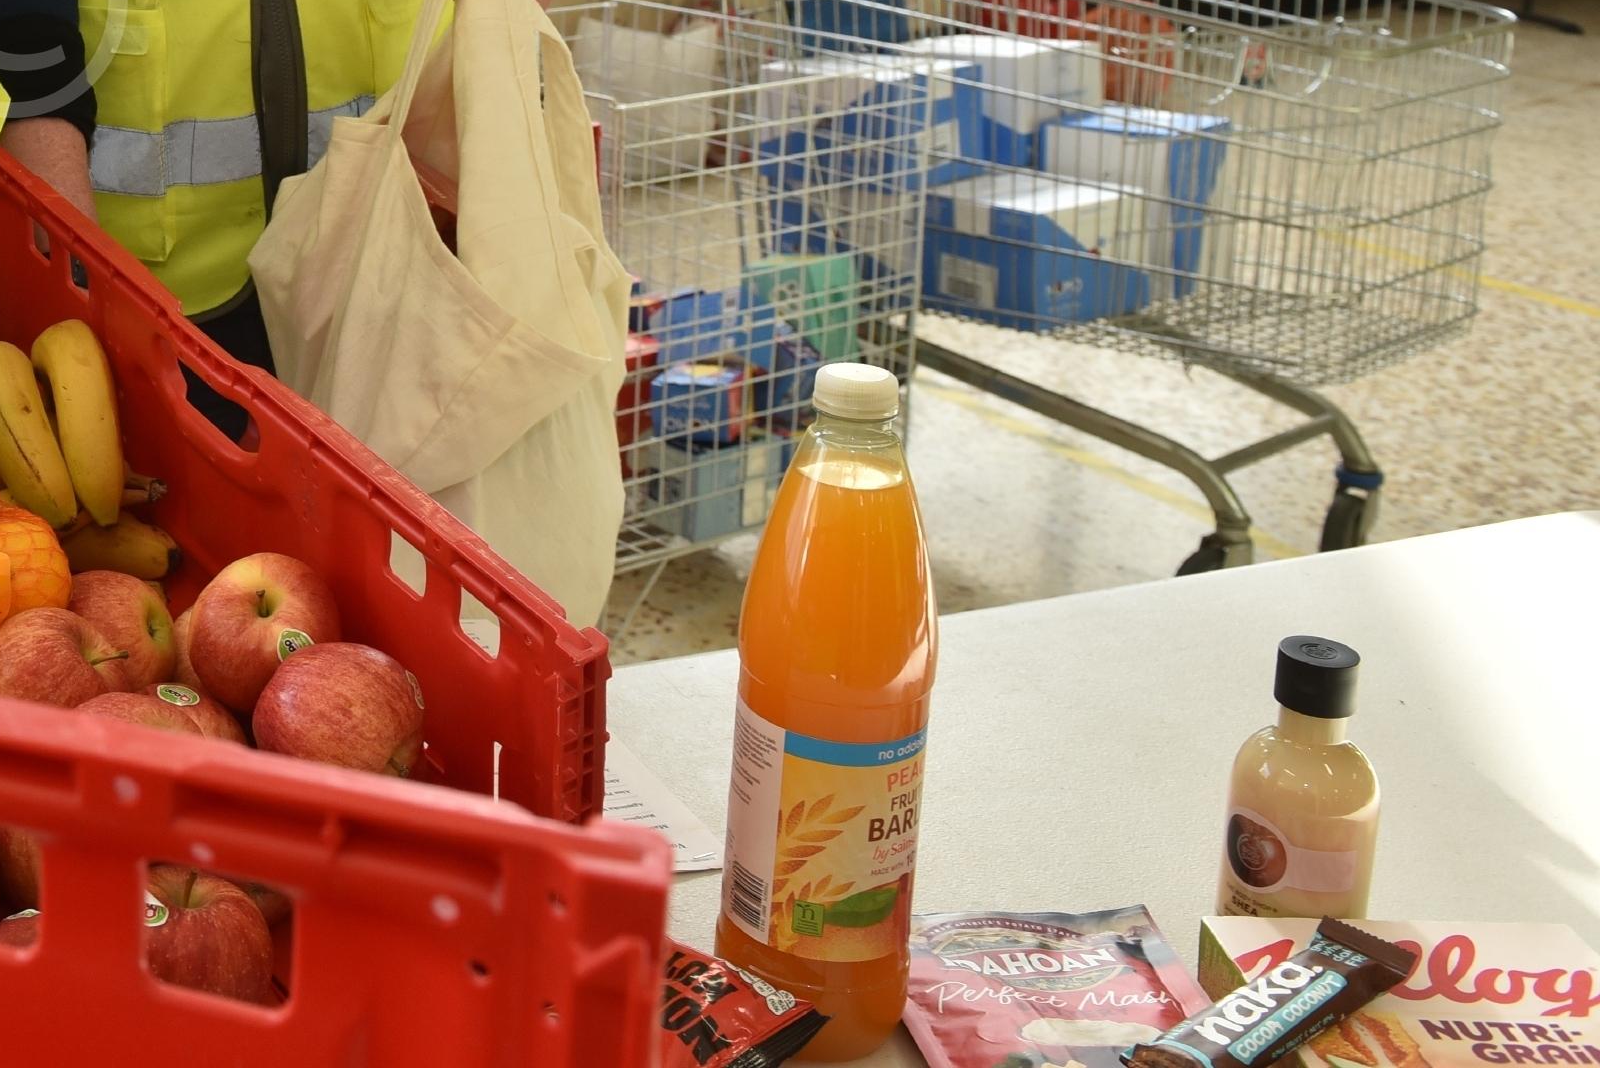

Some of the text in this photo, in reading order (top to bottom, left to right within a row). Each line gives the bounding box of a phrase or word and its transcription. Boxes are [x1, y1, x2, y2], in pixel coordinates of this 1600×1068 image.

[878, 735, 925, 760] no add
[925, 981, 1068, 1014] Perfect
[1235, 1018, 1285, 1058] COCOA
[1281, 974, 1342, 1024] COCONUT
